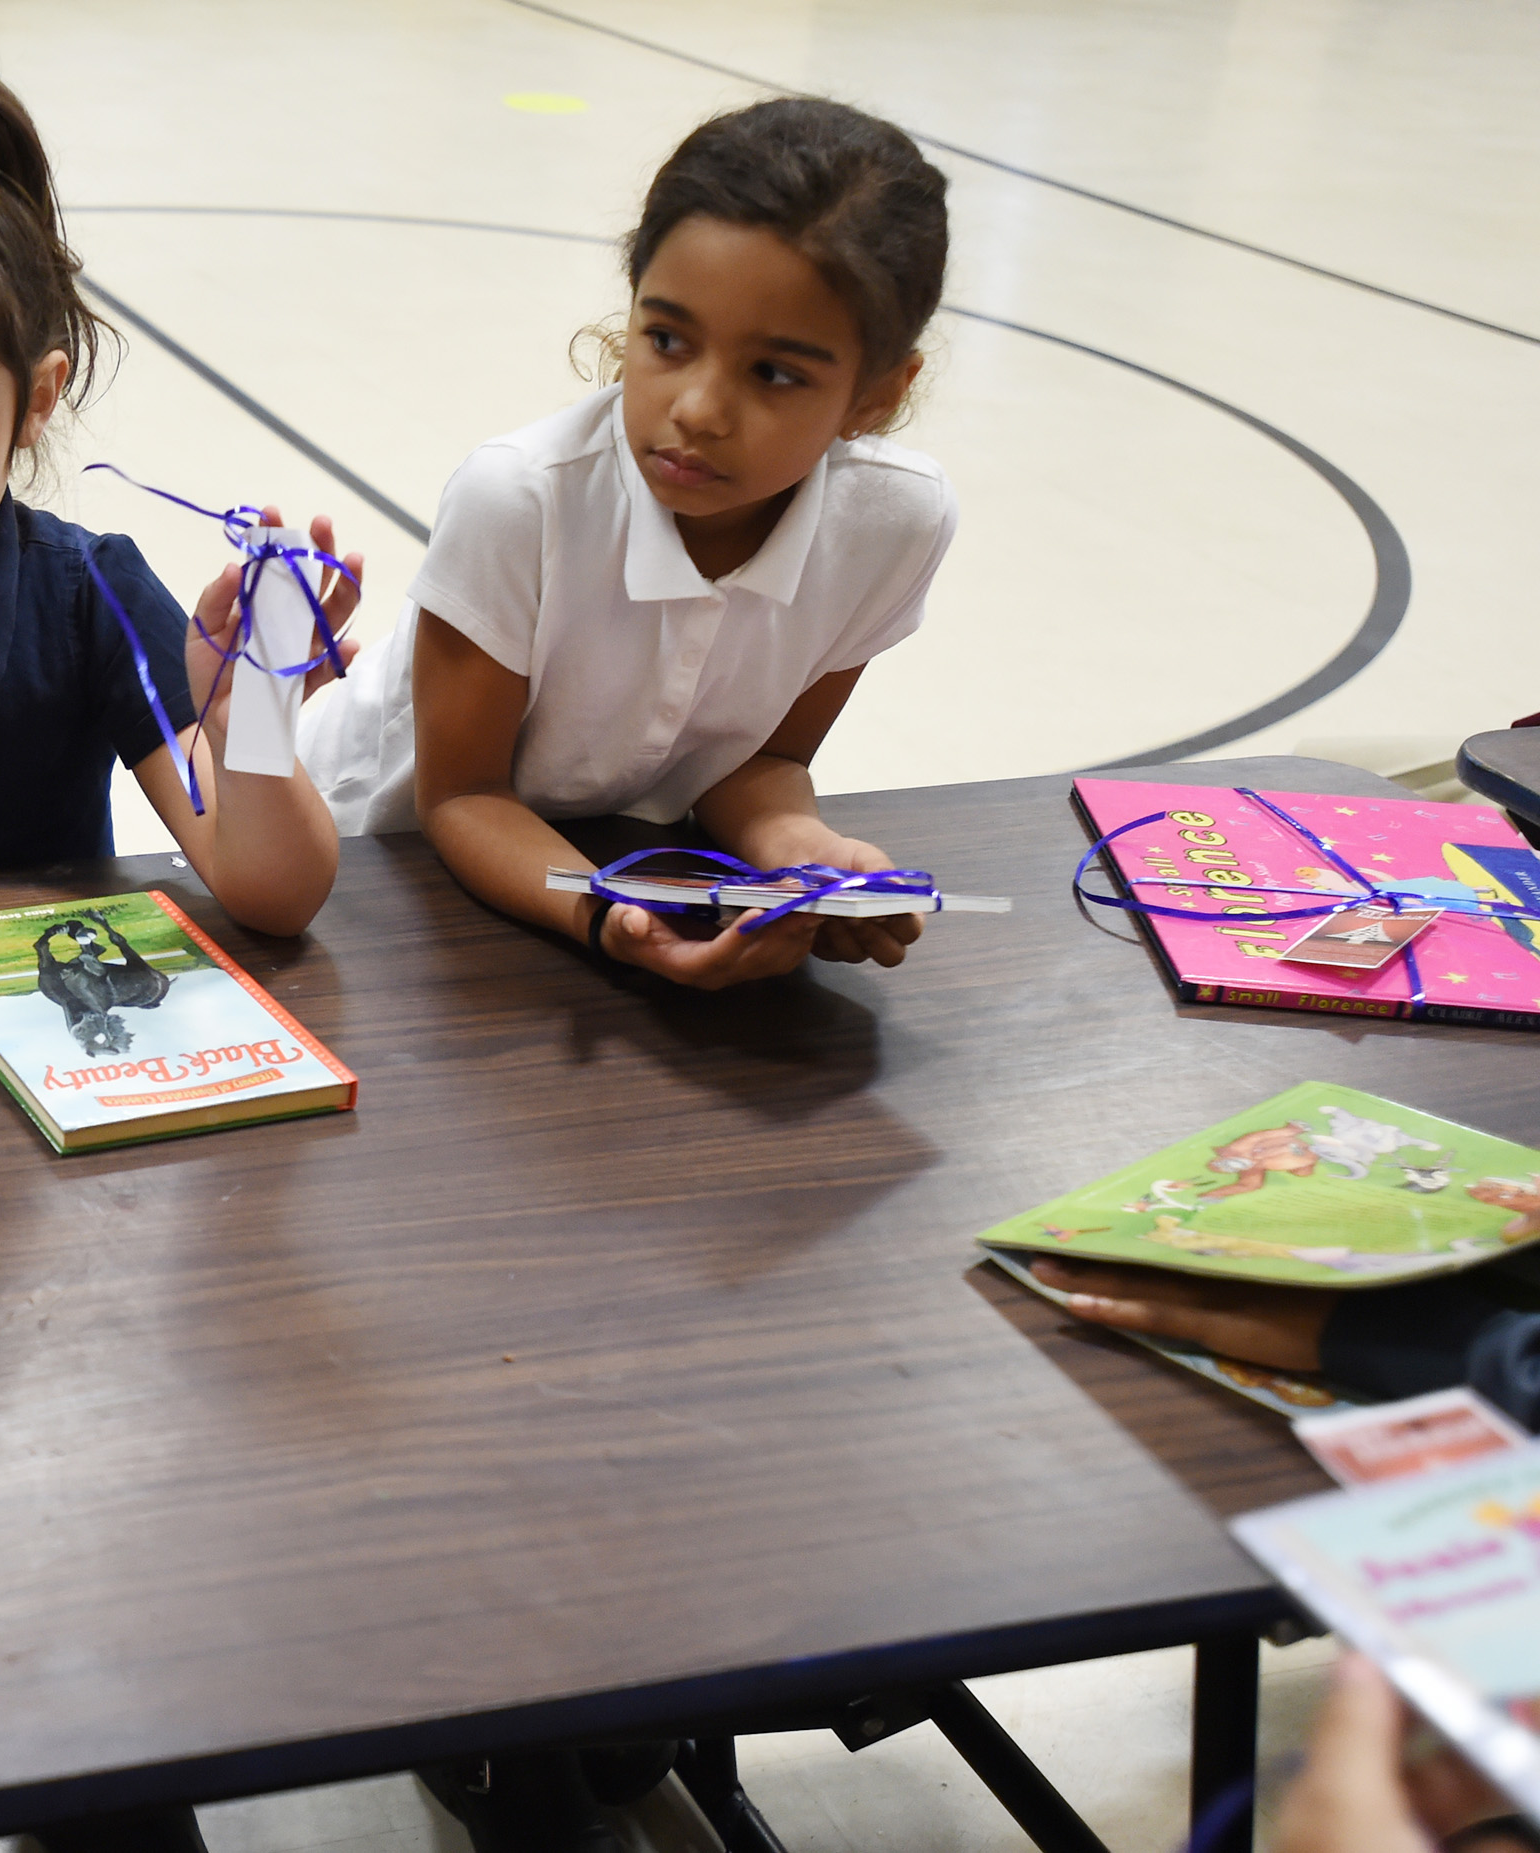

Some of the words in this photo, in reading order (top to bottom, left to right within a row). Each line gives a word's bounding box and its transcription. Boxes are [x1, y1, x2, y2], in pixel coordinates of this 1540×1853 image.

[1228, 988, 1280, 1004] small
[1298, 993, 1389, 1015] Florence
[179, 1038, 305, 1077] Black
[42, 1055, 190, 1091] Beauty
[232, 1070, 279, 1090] Treasury
[159, 1085, 219, 1102] Illustrated
[218, 1083, 233, 1093] of
[102, 1093, 159, 1106] Classics
